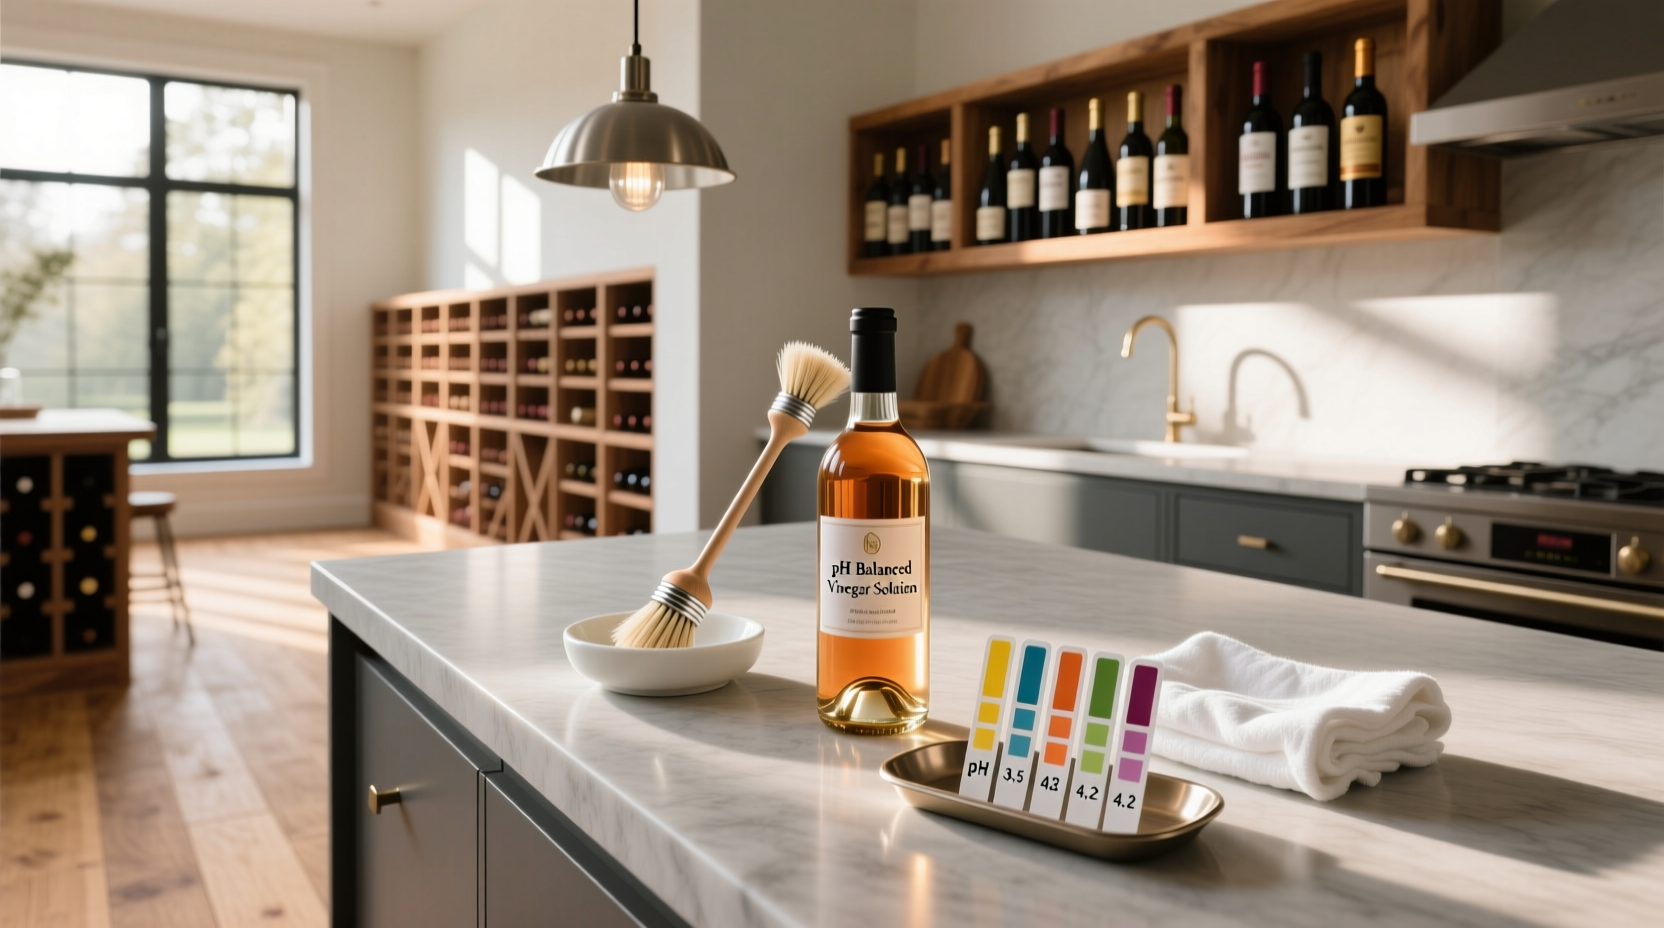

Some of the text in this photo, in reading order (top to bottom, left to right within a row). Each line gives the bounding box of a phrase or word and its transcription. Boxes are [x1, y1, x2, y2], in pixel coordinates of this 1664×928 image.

[831, 560, 912, 578] pH Balanced
[967, 760, 989, 777] pH
[1113, 792, 1136, 809] 4.2
